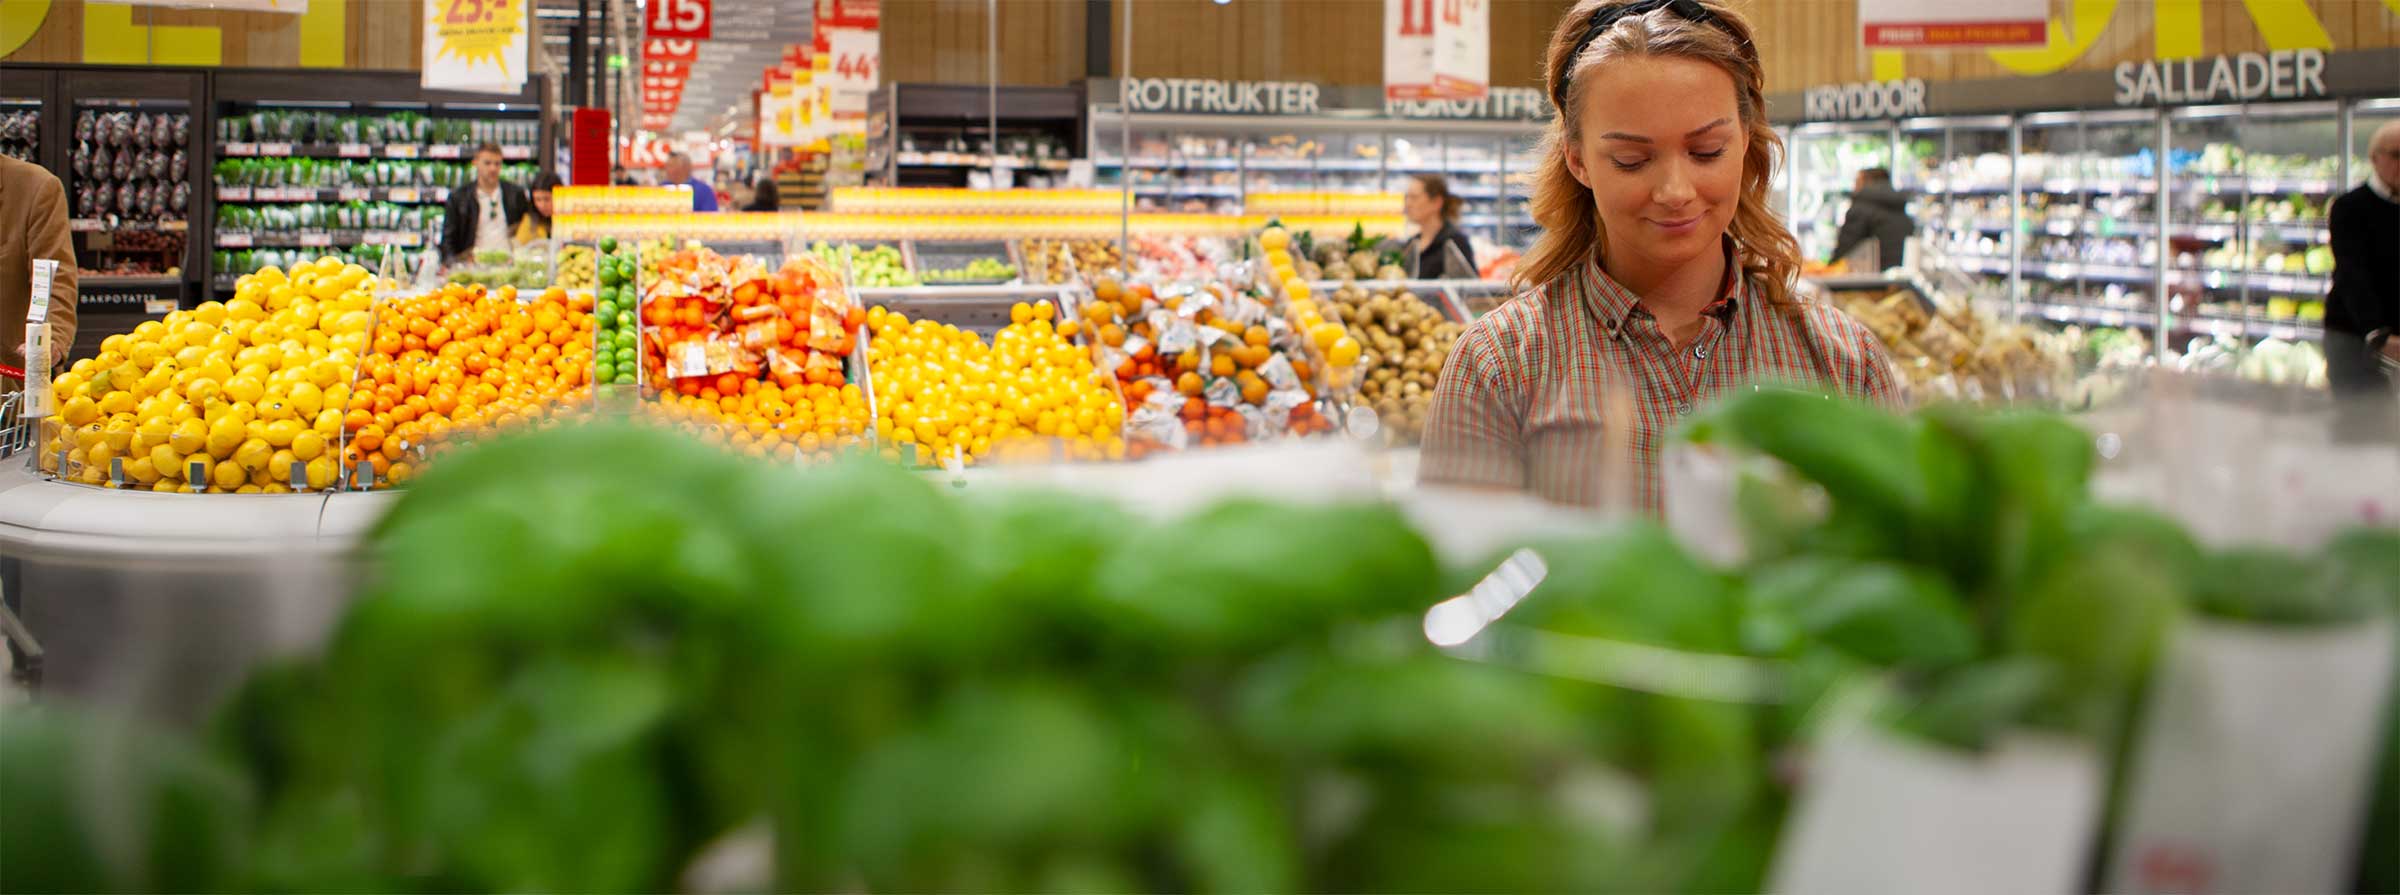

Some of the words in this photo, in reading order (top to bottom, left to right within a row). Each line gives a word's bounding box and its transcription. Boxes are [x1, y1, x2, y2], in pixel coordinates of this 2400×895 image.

[653, 0, 705, 31] 15
[1121, 77, 1320, 113] ROTFRUKTER
[2114, 49, 2327, 105] SALLADER
[1804, 77, 1926, 121] KRYDDOR
